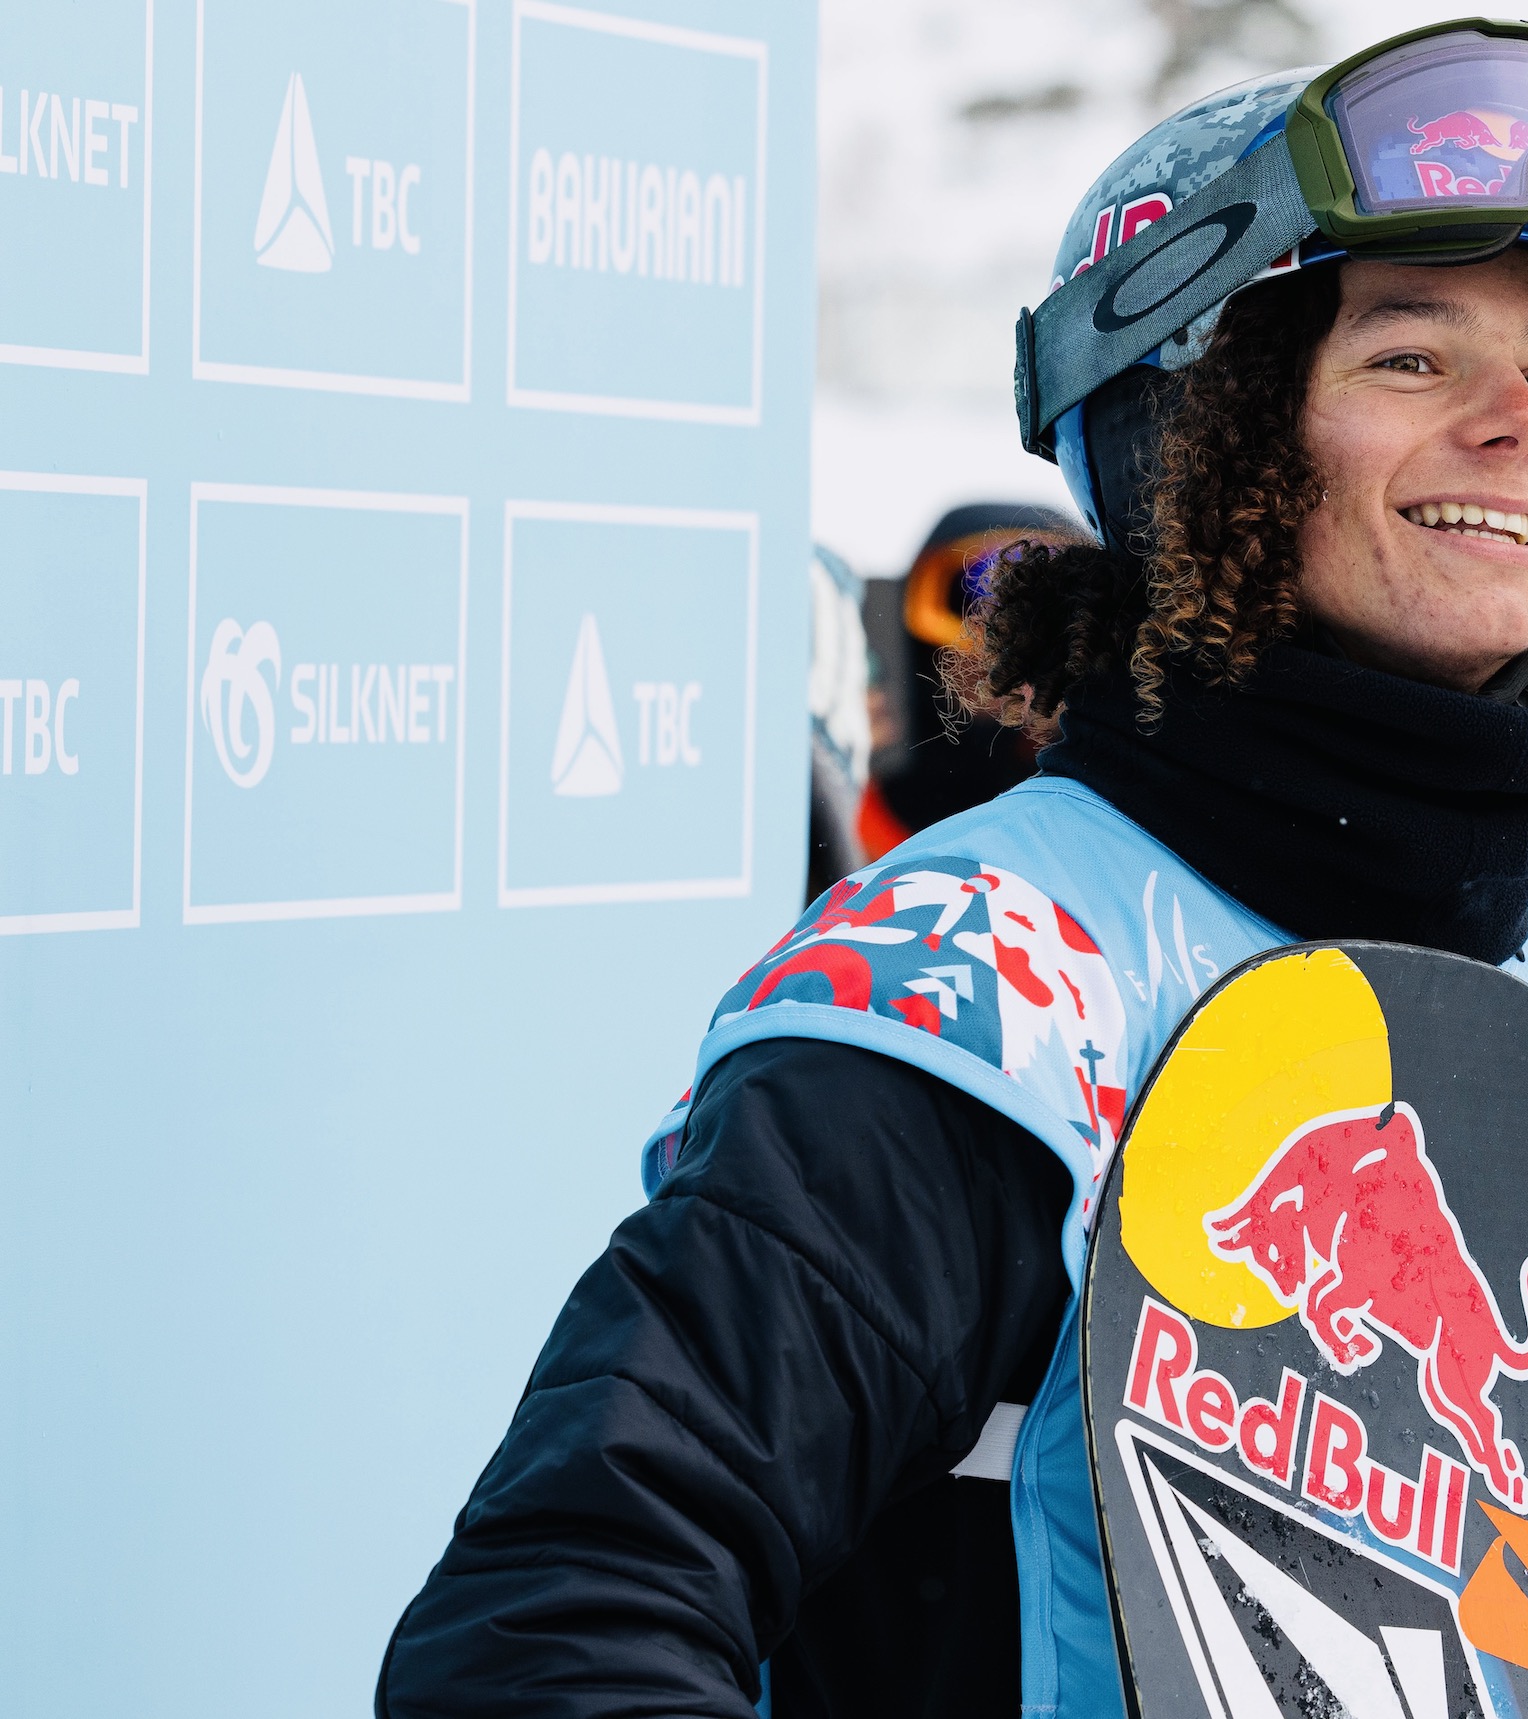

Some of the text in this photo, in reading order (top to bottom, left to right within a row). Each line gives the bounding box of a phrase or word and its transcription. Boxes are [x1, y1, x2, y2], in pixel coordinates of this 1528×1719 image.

[346, 155, 421, 255] TBC
[528, 147, 746, 289] BAKURIANI
[0, 677, 80, 775] TBC
[290, 663, 454, 744] SILKNET
[633, 681, 702, 766] TBC
[1123, 1295, 1471, 1577] Red Bull
